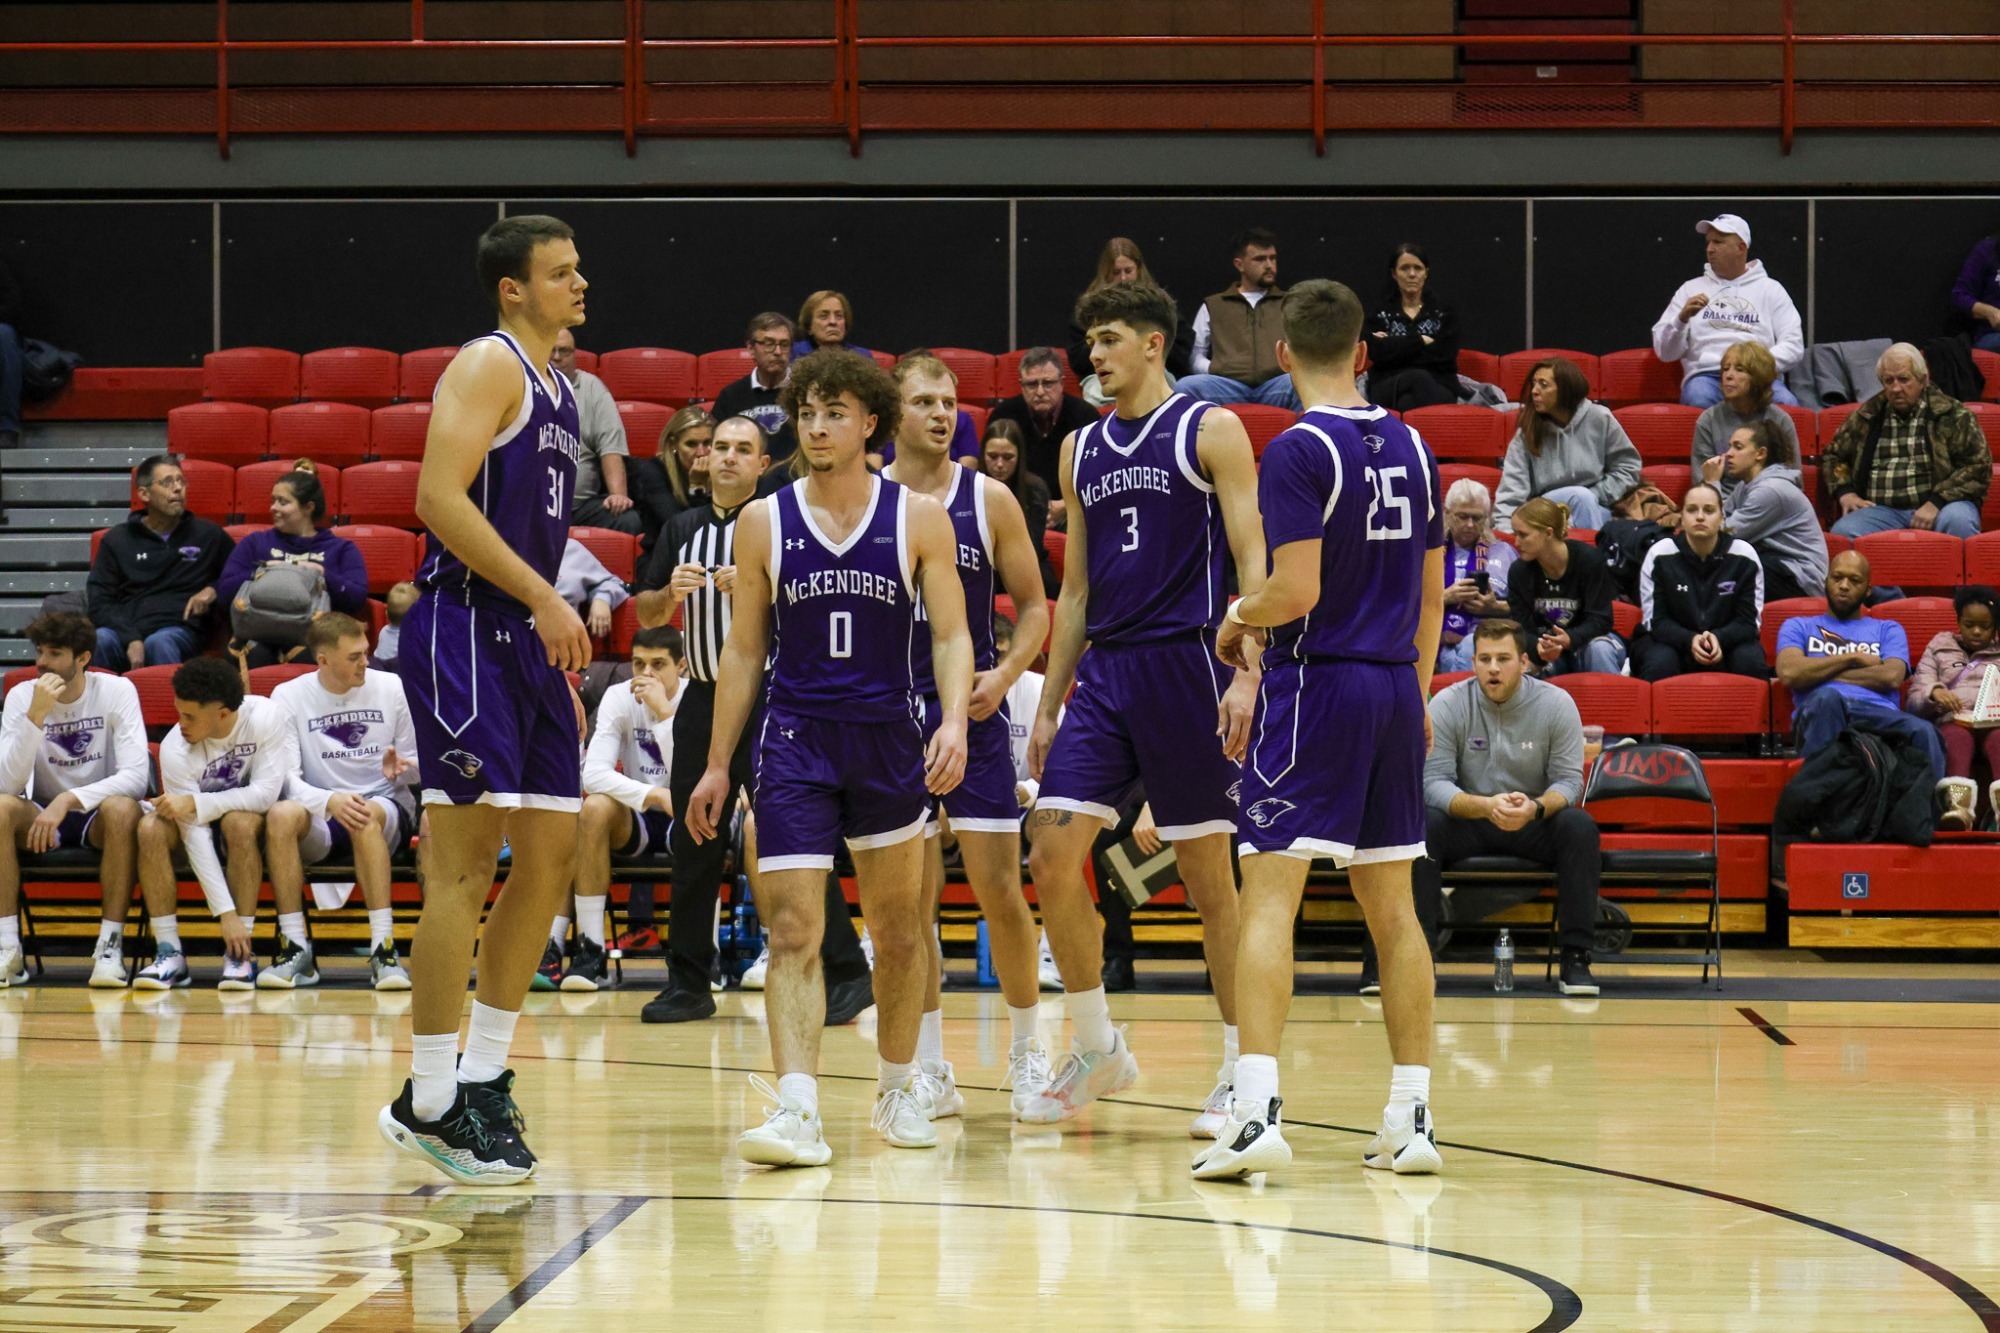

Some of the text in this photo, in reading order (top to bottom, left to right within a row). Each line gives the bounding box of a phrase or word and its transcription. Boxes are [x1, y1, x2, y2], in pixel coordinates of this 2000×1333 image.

[1702, 310, 1760, 323] BASKETBALL
[547, 466, 564, 520] 31
[1081, 466, 1171, 508] McKENDREE
[1364, 466, 1412, 541] 25
[1120, 506, 1140, 553] 3
[784, 569, 897, 606] McKENDREE
[829, 611, 852, 658] 0
[308, 709, 384, 732] McKENDREE
[321, 745, 380, 759] BASKETBALL
[1603, 750, 1691, 785] UMSL
